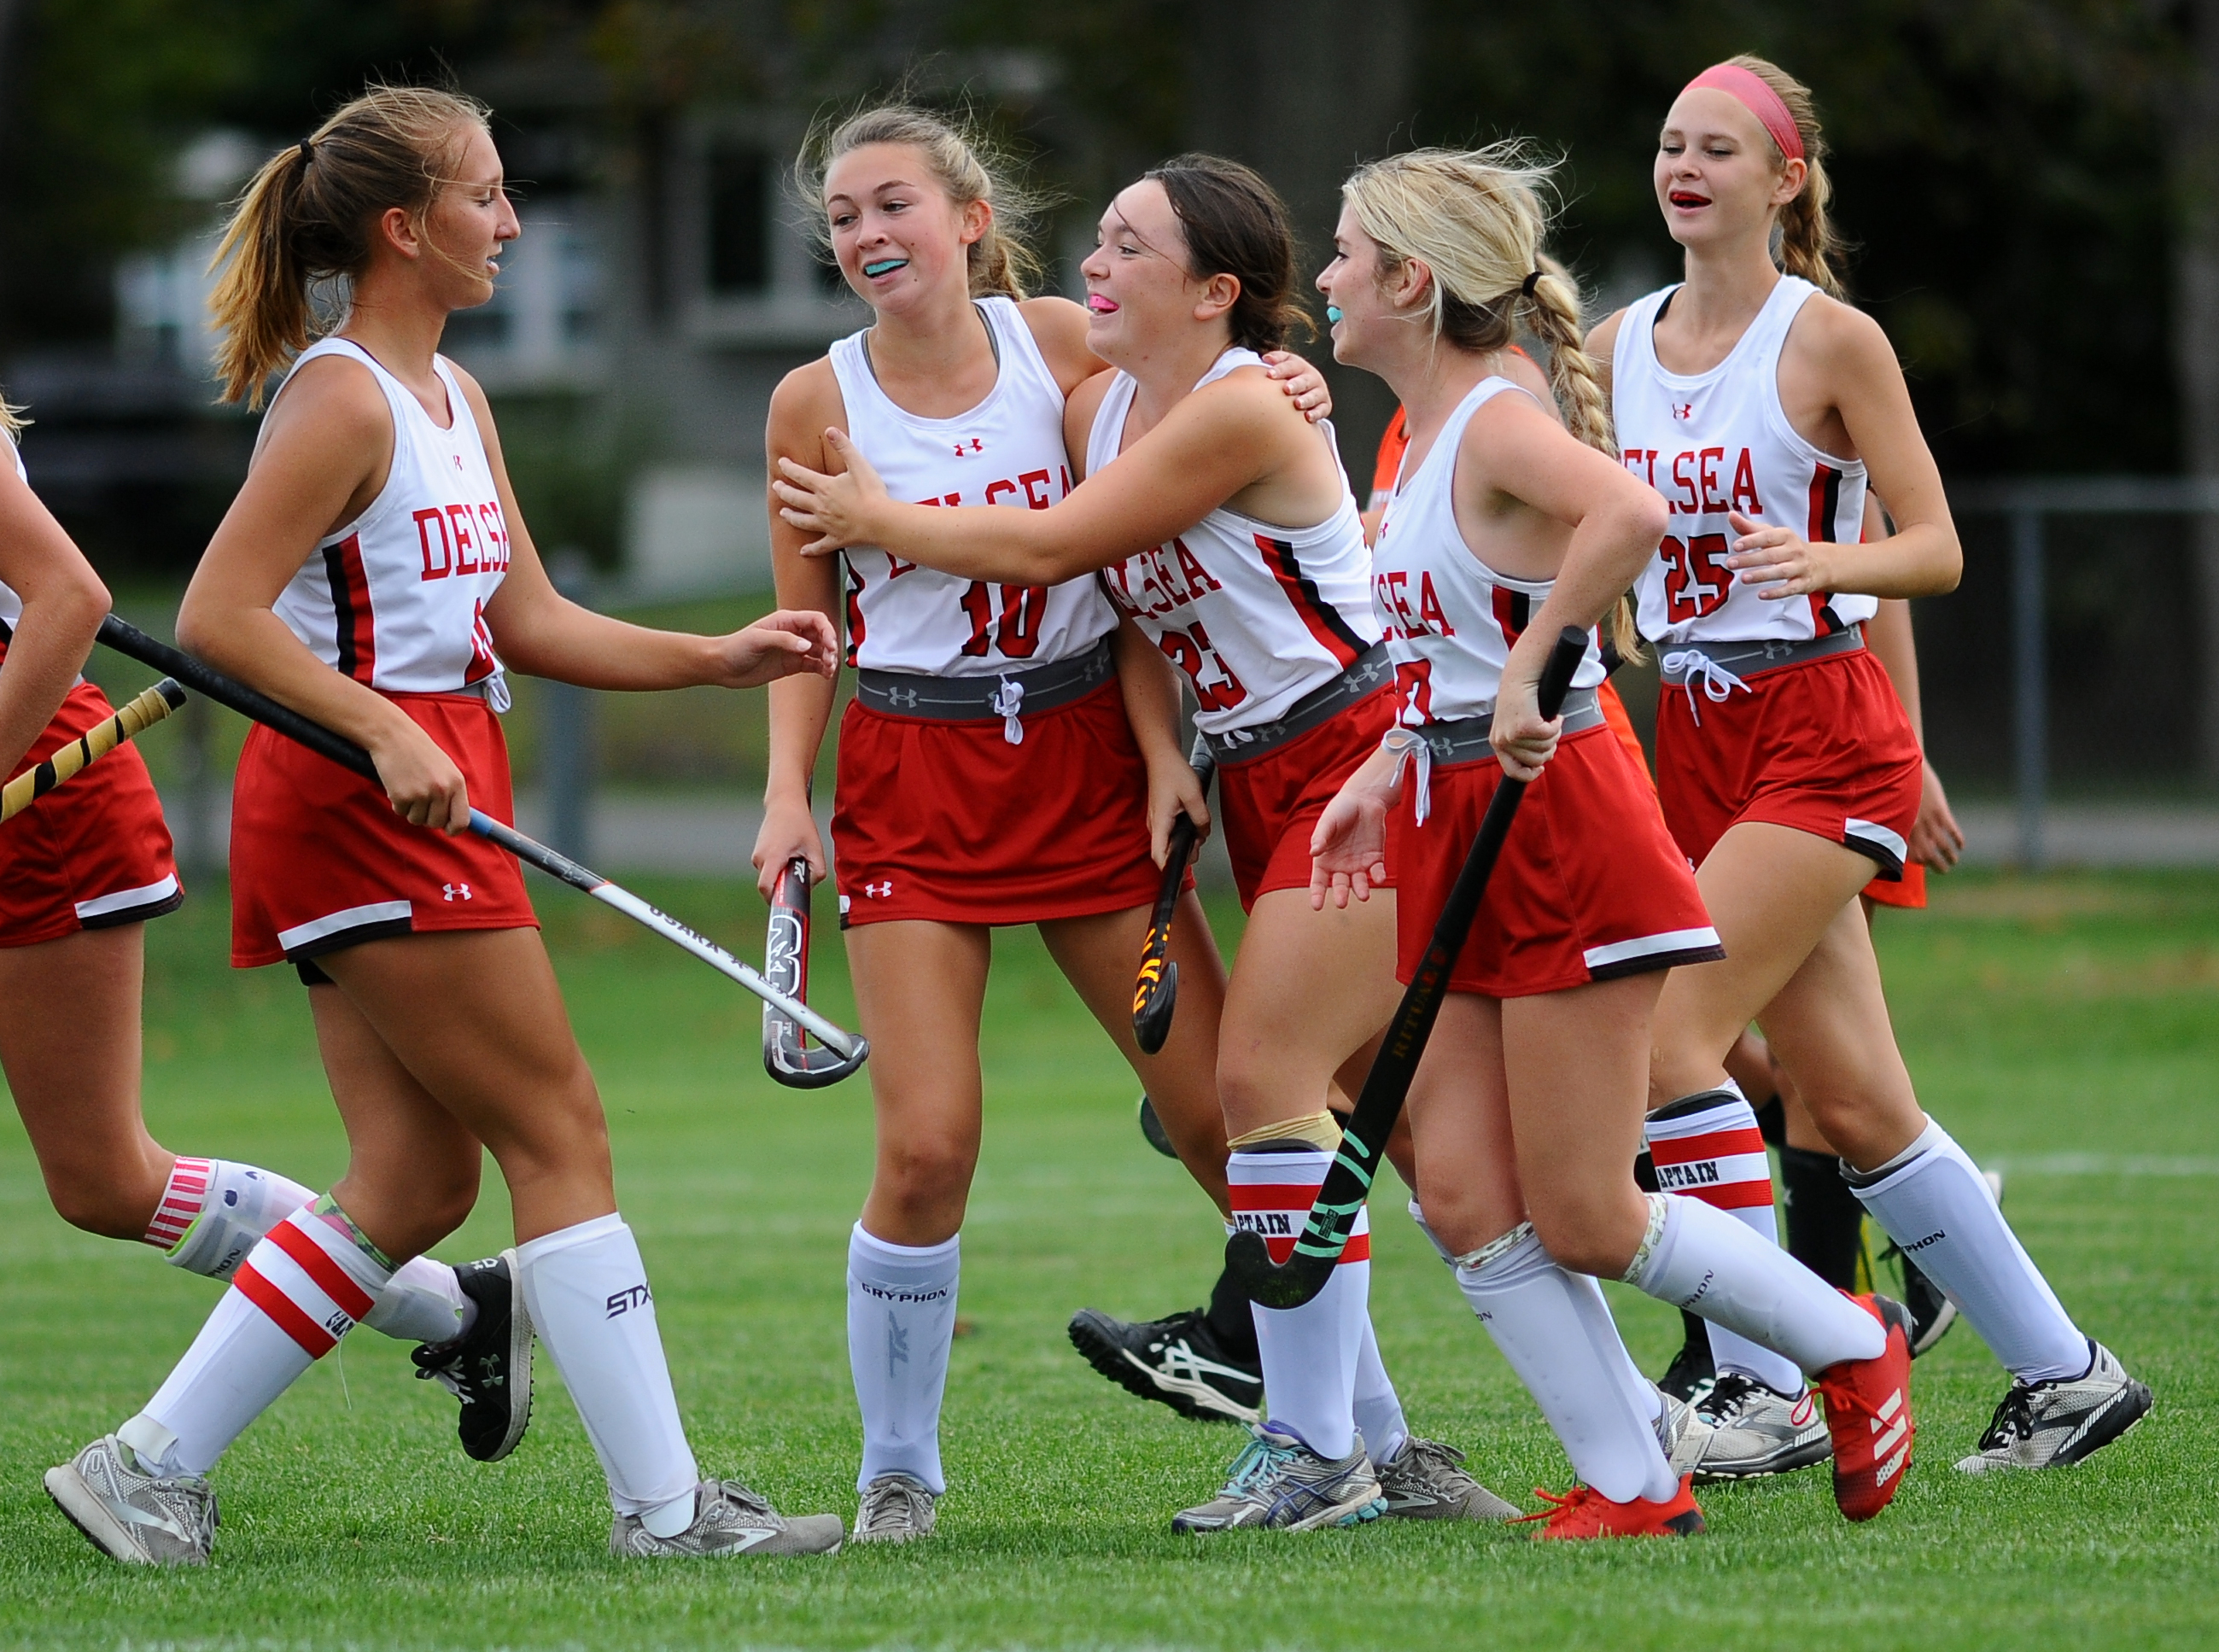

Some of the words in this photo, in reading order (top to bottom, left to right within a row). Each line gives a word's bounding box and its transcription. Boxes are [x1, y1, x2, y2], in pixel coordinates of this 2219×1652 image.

[1370, 571, 1456, 642] SEA
[1659, 533, 1735, 624] 25
[960, 581, 1048, 658] 10
[605, 1280, 652, 1321] STX
[861, 1281, 949, 1303] GRYPHON
